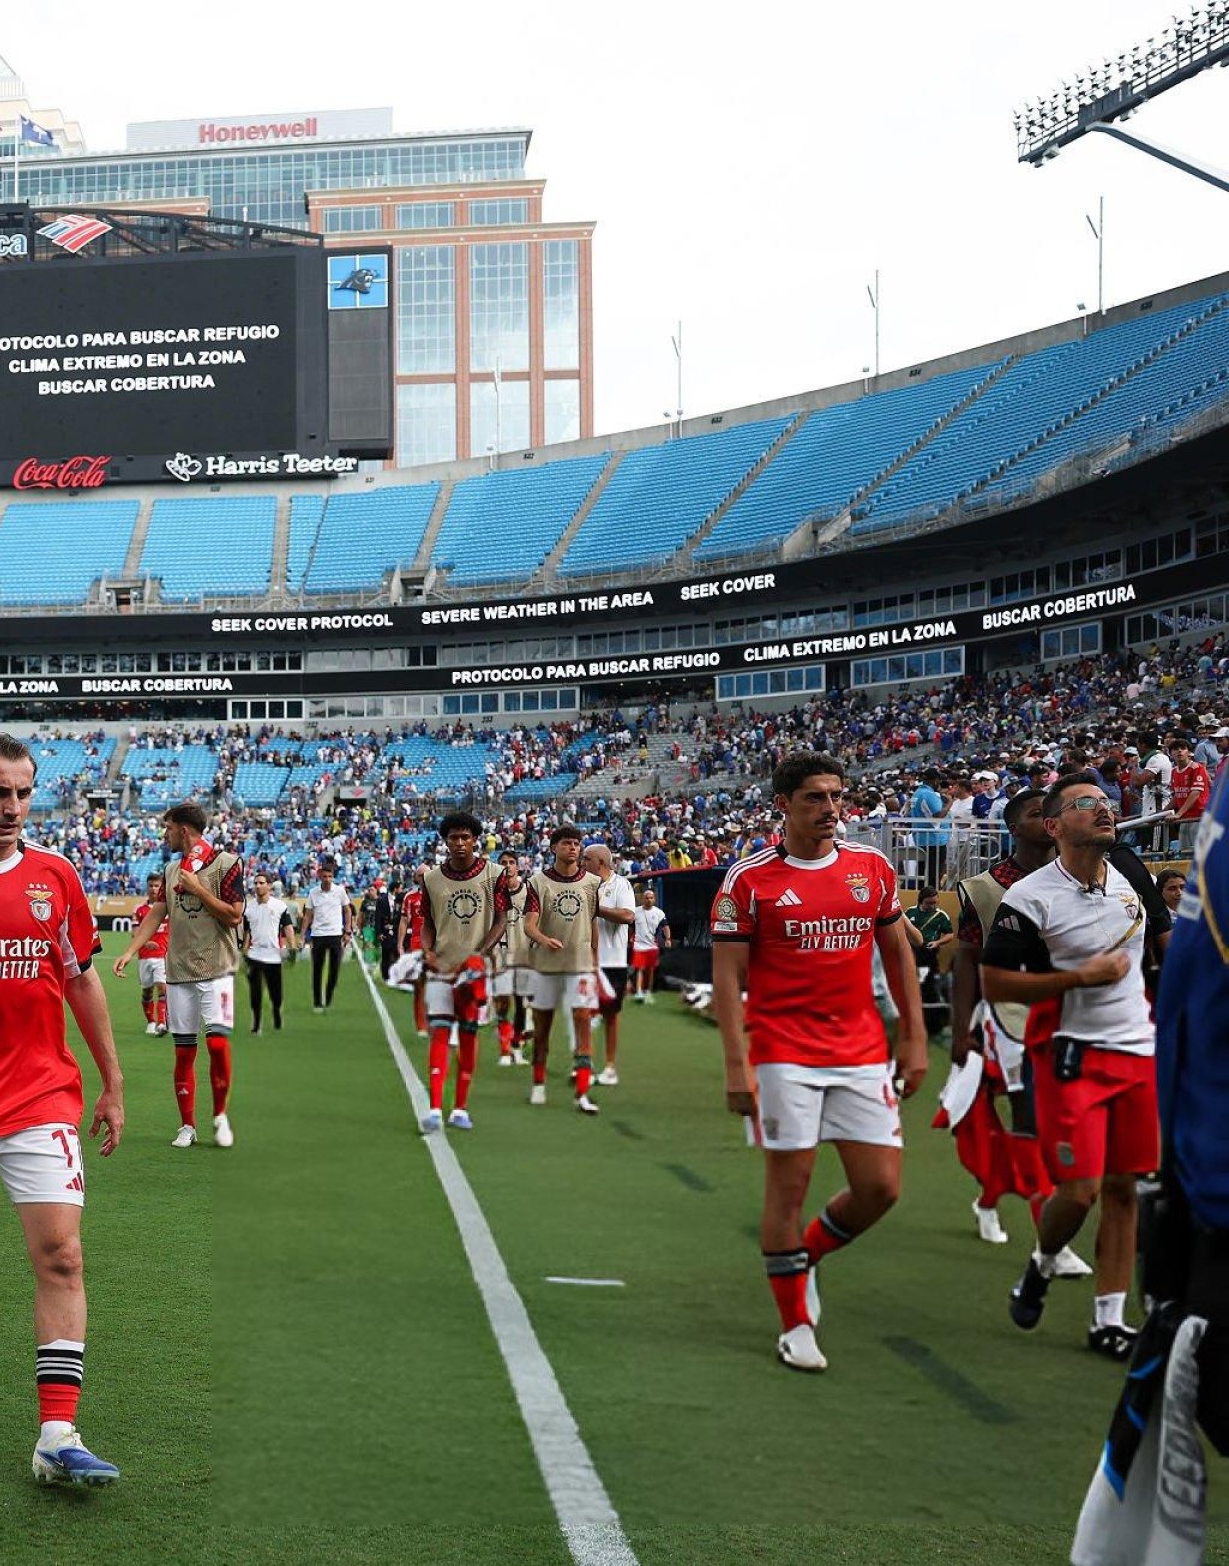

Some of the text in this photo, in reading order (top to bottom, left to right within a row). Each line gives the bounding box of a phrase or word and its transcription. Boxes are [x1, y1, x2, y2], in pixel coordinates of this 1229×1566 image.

[199, 118, 317, 143] Honeywell
[82, 332, 127, 346] PARA
[130, 329, 200, 344] BUSCAR
[204, 325, 279, 341] REFUGIO
[9, 350, 245, 373] CLIMA EXTREMO EN LA ZONA
[39, 375, 215, 395] BUSCAR COBERTURA
[206, 454, 358, 475] Harris Teeter
[681, 574, 775, 600] SEEK COVER
[422, 592, 653, 624] SEVERE WEATHER IN THE AREA
[983, 585, 1135, 629] BUSCAR COBERTURA
[212, 614, 393, 631] SEEK COVER PROTOCOL
[744, 621, 956, 661] CLIMA EXTREMO EN LA ZONA
[453, 653, 720, 684] PROTOCOLO PARA BUSCAR REFUGIO
[0, 682, 17, 693] LA
[19, 681, 58, 693] ZONA
[82, 679, 232, 692] BUSCAR COBERTURA
[785, 915, 872, 937] Emirates
[824, 935, 861, 949] BETTER
